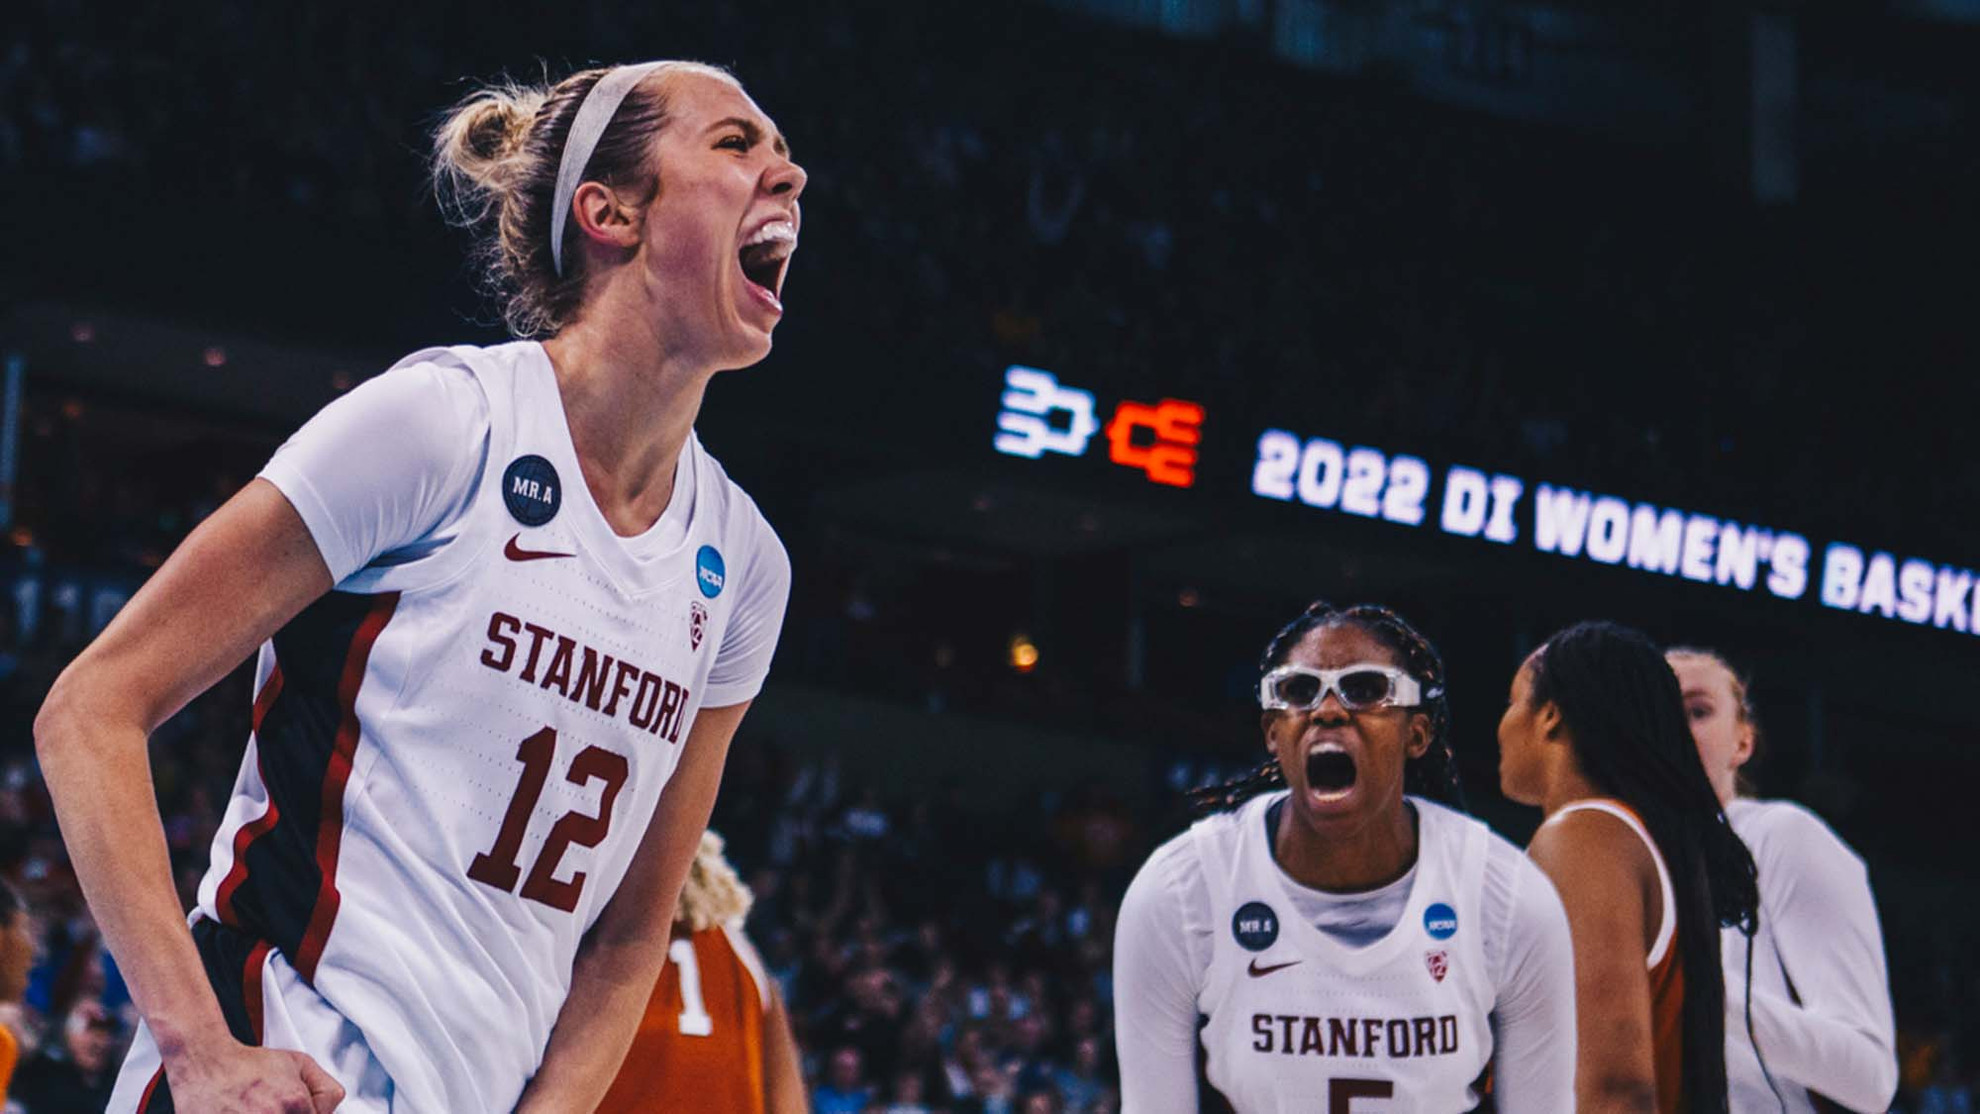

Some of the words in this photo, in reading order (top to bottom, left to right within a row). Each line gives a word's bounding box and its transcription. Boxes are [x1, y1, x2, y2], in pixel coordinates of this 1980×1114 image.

[1253, 429, 1430, 526] 2022
[1441, 465, 1522, 544] DI
[1534, 482, 1811, 599] WOMEN'S
[480, 612, 690, 744] STANFORD
[466, 726, 629, 914] 12
[1252, 1013, 1458, 1058] STANFORD
